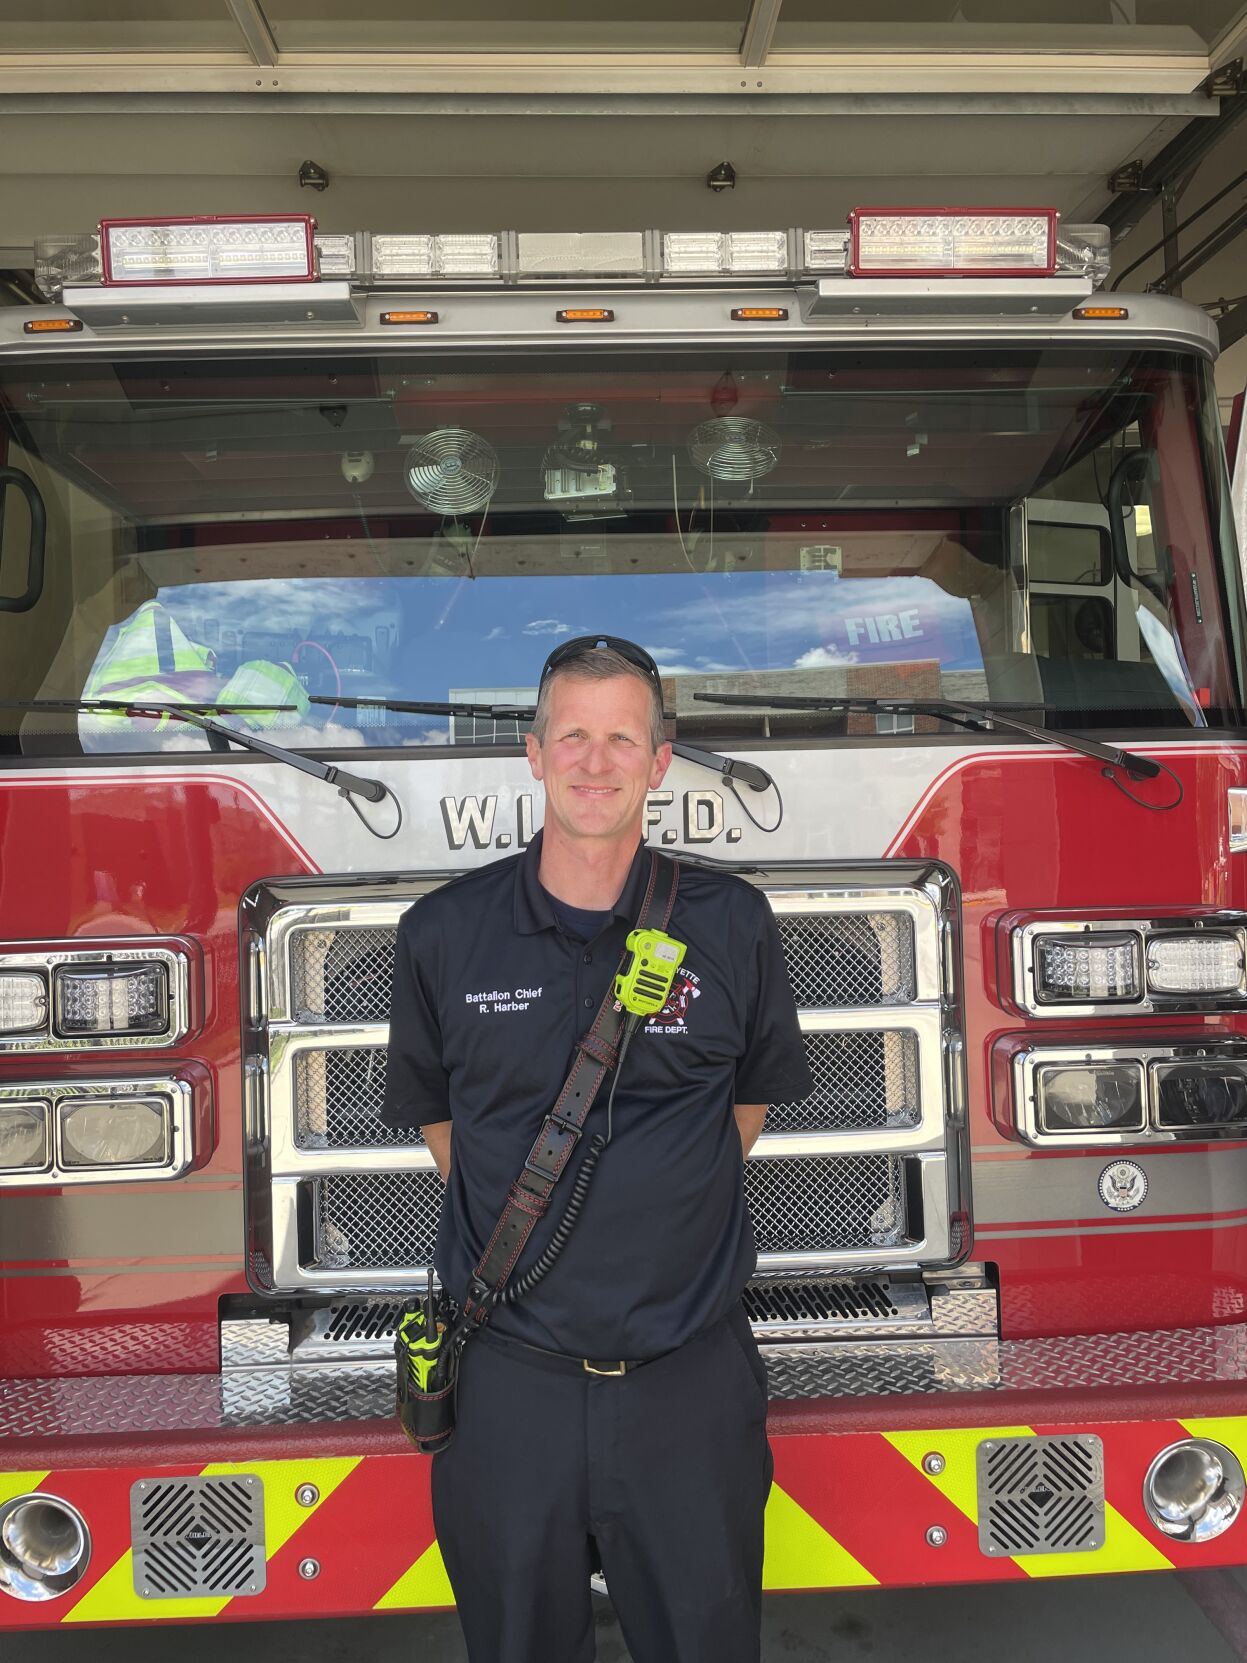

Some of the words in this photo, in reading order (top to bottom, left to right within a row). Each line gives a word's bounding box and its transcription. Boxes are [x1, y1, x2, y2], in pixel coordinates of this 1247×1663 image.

[844, 608, 923, 646] FIRE
[676, 966, 701, 985] YETTE
[465, 990, 511, 1003] Battalion
[514, 987, 543, 999] Chief
[479, 1004, 490, 1014] R.
[494, 1002, 529, 1012] Harber
[644, 1026, 663, 1034] FIRE
[665, 1026, 689, 1034] DEPT.
